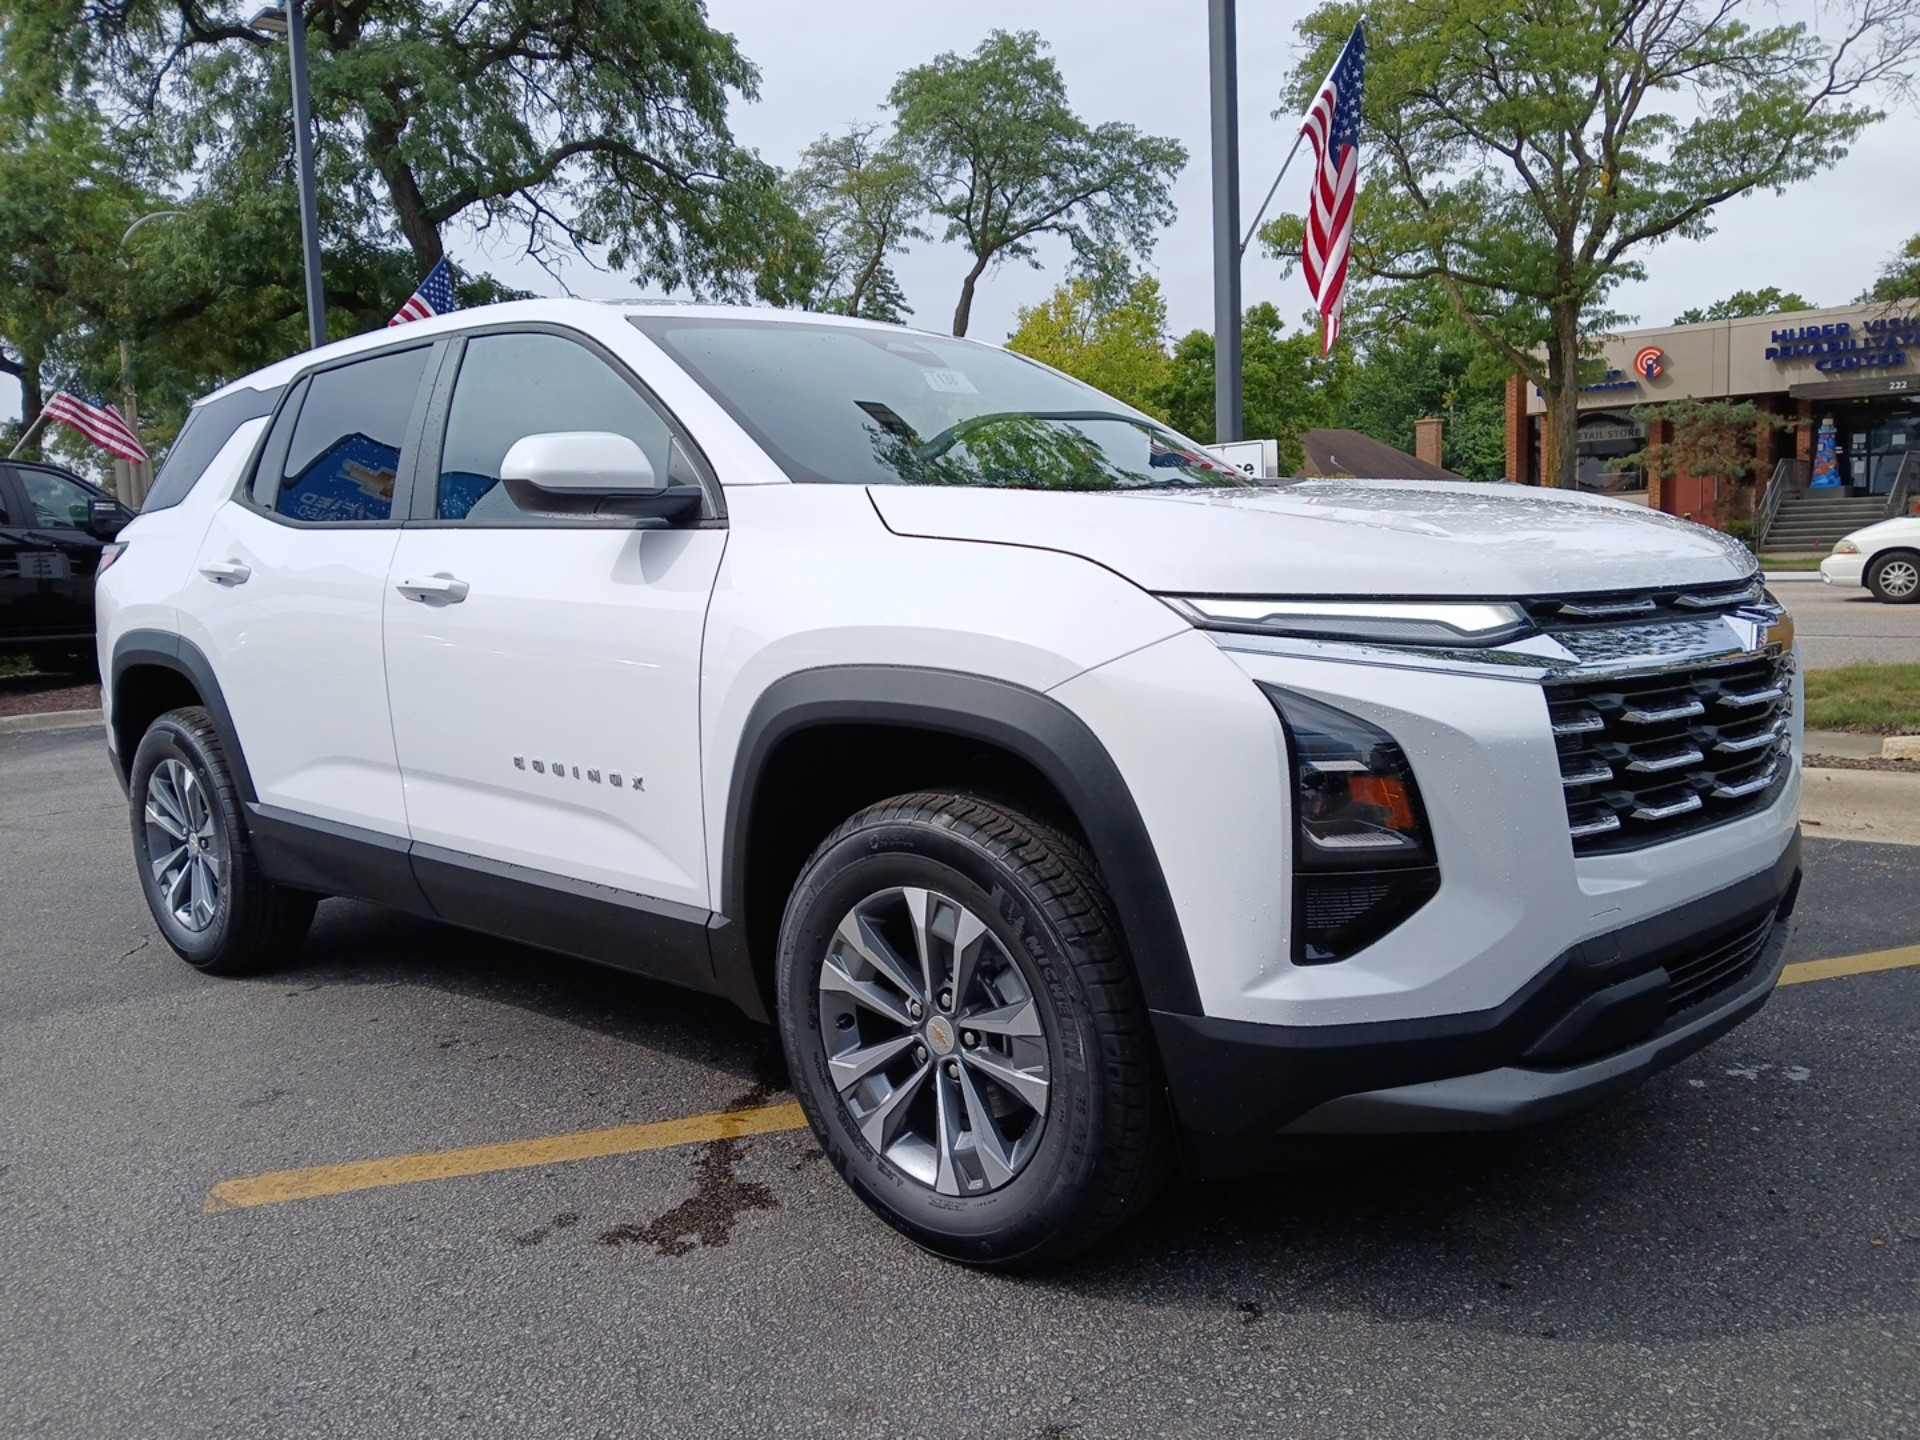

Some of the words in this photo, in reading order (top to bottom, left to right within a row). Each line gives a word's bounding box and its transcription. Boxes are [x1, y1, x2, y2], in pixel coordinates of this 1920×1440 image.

[1771, 322, 1850, 343] HUBER
[1815, 350, 1906, 372] CENTER
[1889, 381, 1908, 390] 222
[1576, 430, 1604, 441] ETAIL
[1608, 427, 1641, 438] STORE
[513, 756, 645, 791] EQUINOX
